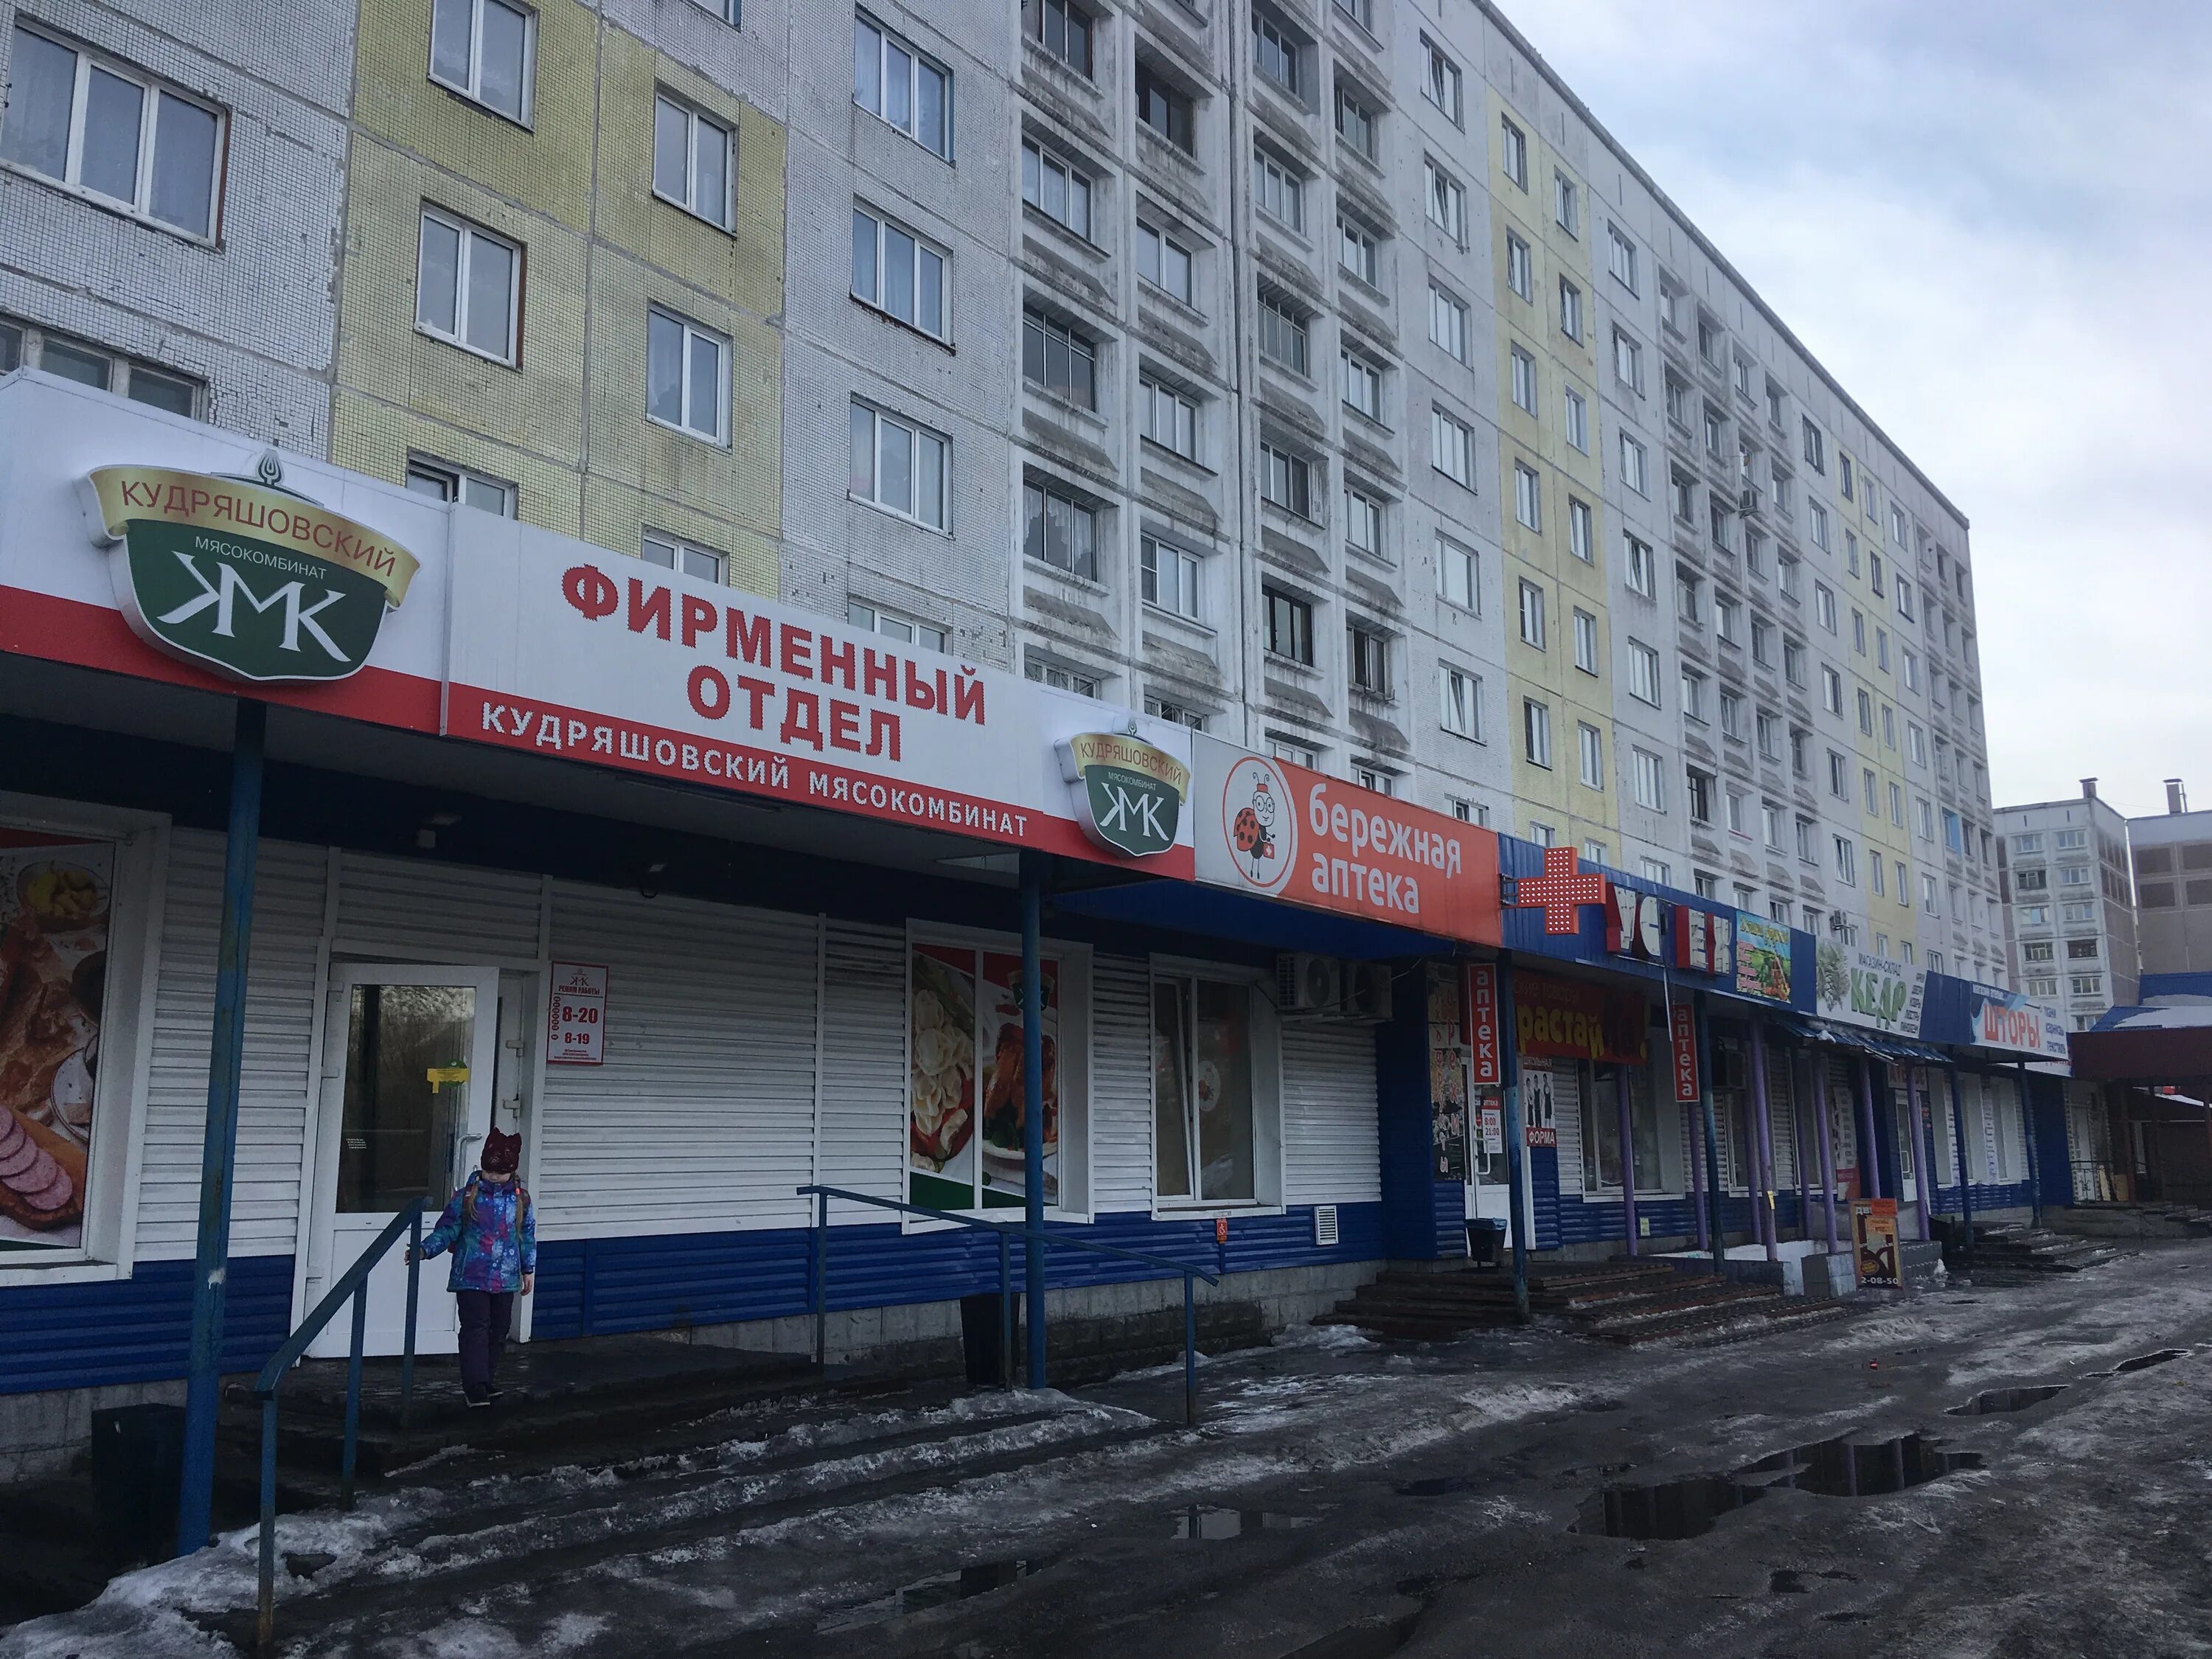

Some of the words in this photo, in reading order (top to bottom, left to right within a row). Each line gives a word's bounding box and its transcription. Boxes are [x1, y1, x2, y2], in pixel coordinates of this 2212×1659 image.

[121, 480, 397, 578] КУДРЯШОВСКИЙ
[195, 536, 327, 580] МЯСОКОМБИНАТ
[561, 563, 986, 726] ФИРМЕННЫЙ
[686, 664, 902, 762] ОТДЕЛ
[481, 700, 789, 790] КУДРЯШОВСКИЙ
[809, 771, 1028, 837] МЯСОКОМБИНАТ
[1080, 742, 1183, 785] КУДРЯШОВСКИЙ
[1107, 771, 1156, 791] МЯСОКОМБИНАТ
[1308, 782, 1461, 880] бережная
[1311, 851, 1419, 914] аптека
[563, 1006, 598, 1024] 8-20
[578, 986, 599, 995] РАБОТЫ
[1851, 967, 1907, 1030] КЕДР
[565, 1032, 590, 1045] 8-19
[1476, 970, 1493, 1077] аптека
[1983, 1003, 2041, 1048] ШТОРЫ
[1677, 1008, 1693, 1096] аптека
[1528, 1130, 1556, 1145] ФОРМА
[1861, 1276, 1899, 1285] 2-08-50
